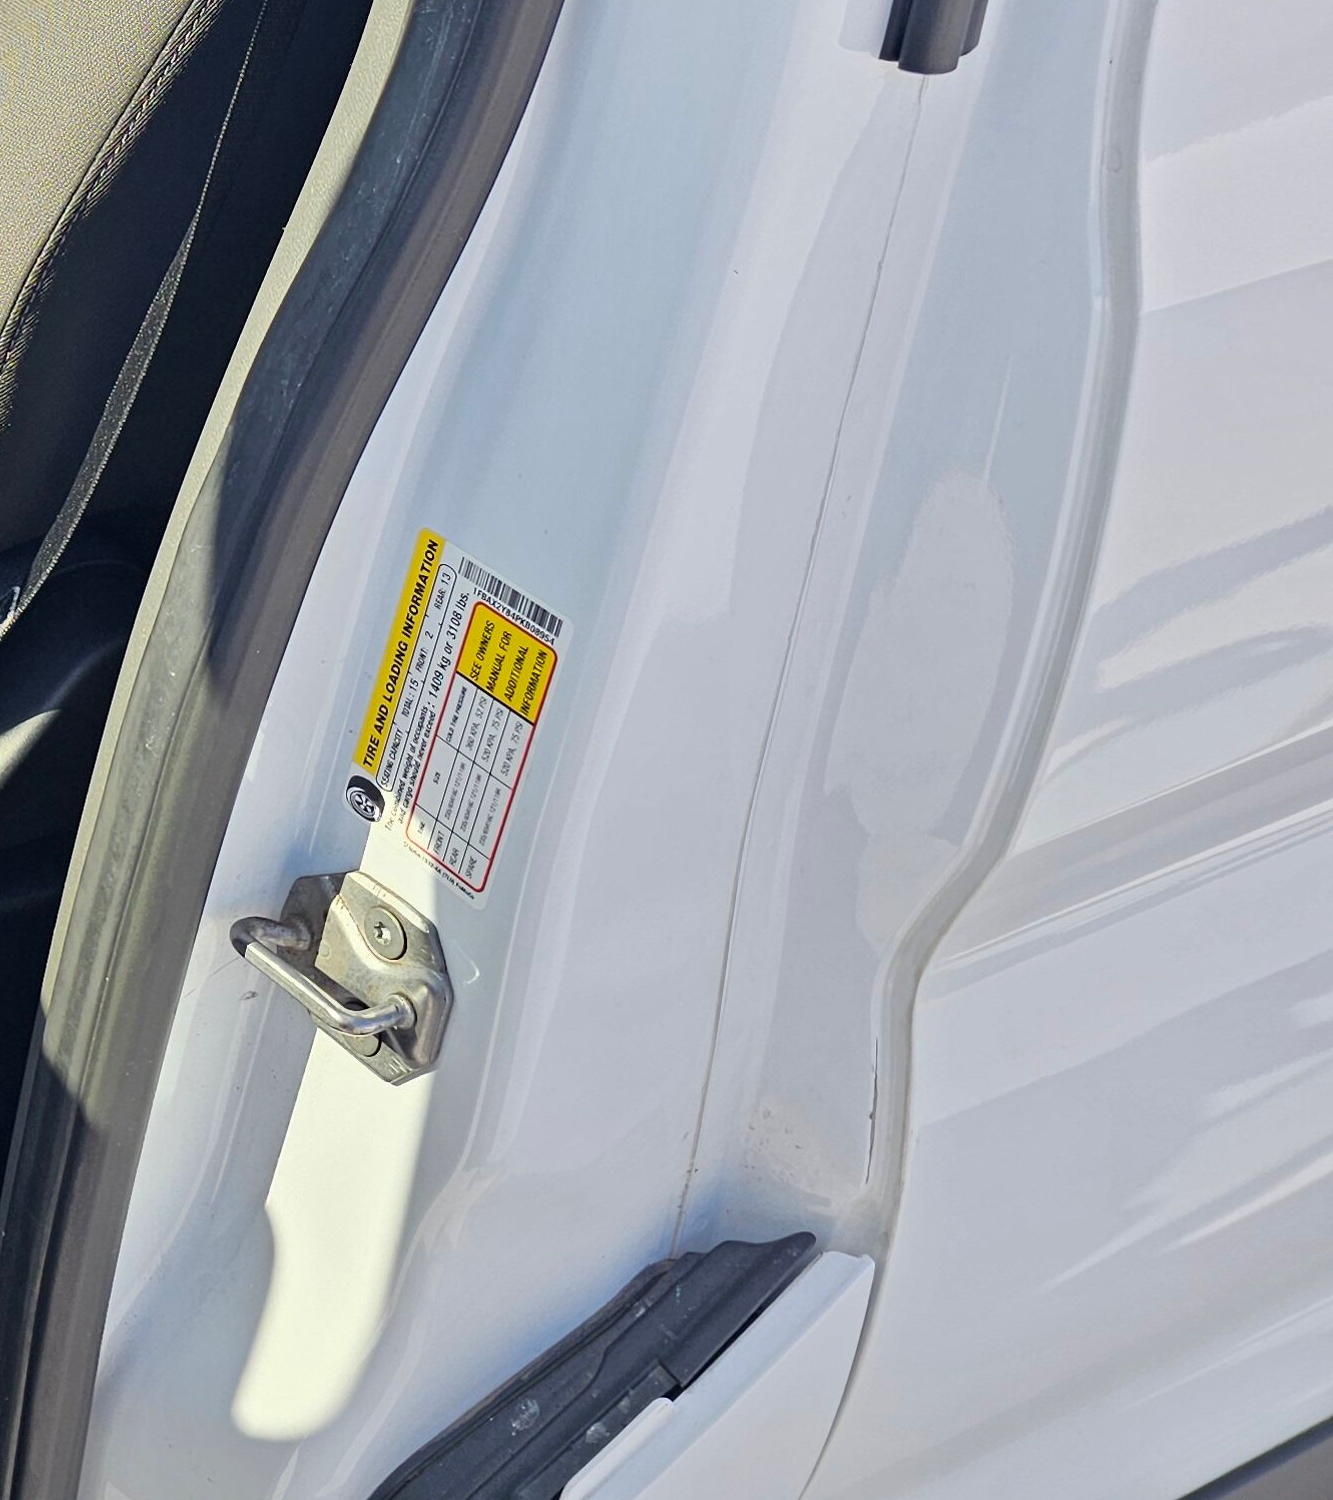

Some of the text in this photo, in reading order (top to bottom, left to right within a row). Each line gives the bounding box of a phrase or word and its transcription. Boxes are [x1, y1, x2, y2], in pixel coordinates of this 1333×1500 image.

[363, 539, 438, 767] TIRE AND LOADING INFORMATION
[429, 670, 443, 698] 1409
[437, 656, 451, 671] kg
[446, 610, 462, 640] 3108
[455, 592, 469, 611] lbs.
[469, 620, 494, 681] SEE OWNERS
[486, 631, 512, 693] MANUAL FOR
[504, 646, 529, 702] ADDITIONAL
[520, 650, 547, 716] INFORMATION
[381, 760, 393, 787] SEATING
[389, 728, 403, 760] CAPACITY
[385, 817, 394, 831] The
[402, 753, 415, 779] weight
[413, 706, 430, 744] occupants
[398, 710, 435, 824] and cargo should never exceed
[433, 831, 444, 855] FRONT
[449, 848, 459, 866] REAR
[465, 856, 477, 879] SPARE
